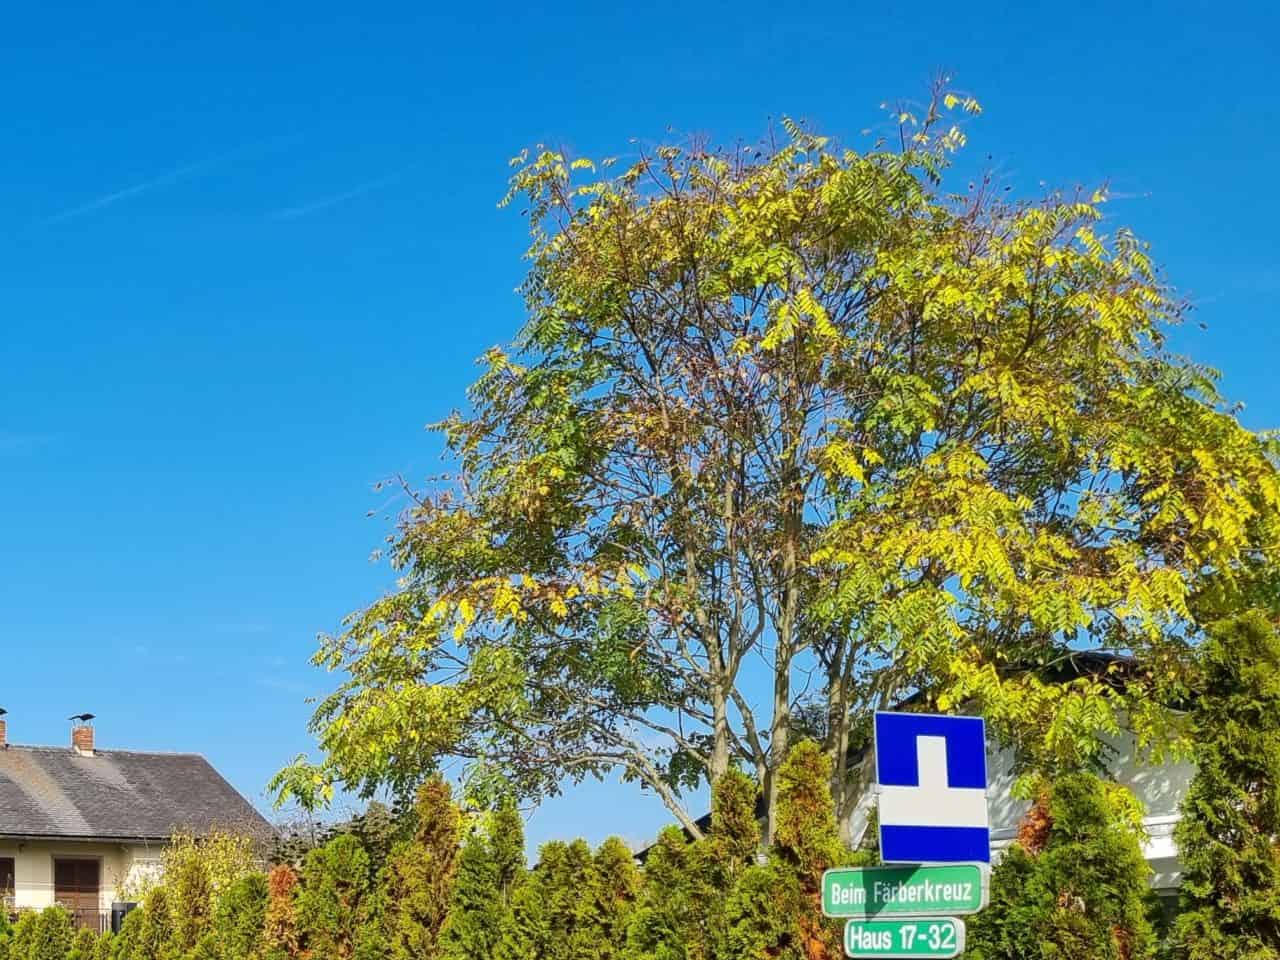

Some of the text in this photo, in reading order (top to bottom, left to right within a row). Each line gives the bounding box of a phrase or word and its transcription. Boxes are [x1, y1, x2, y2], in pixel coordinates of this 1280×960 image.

[831, 881, 973, 905] Beim Färberkreuz
[850, 923, 956, 950] Haus 17-32
